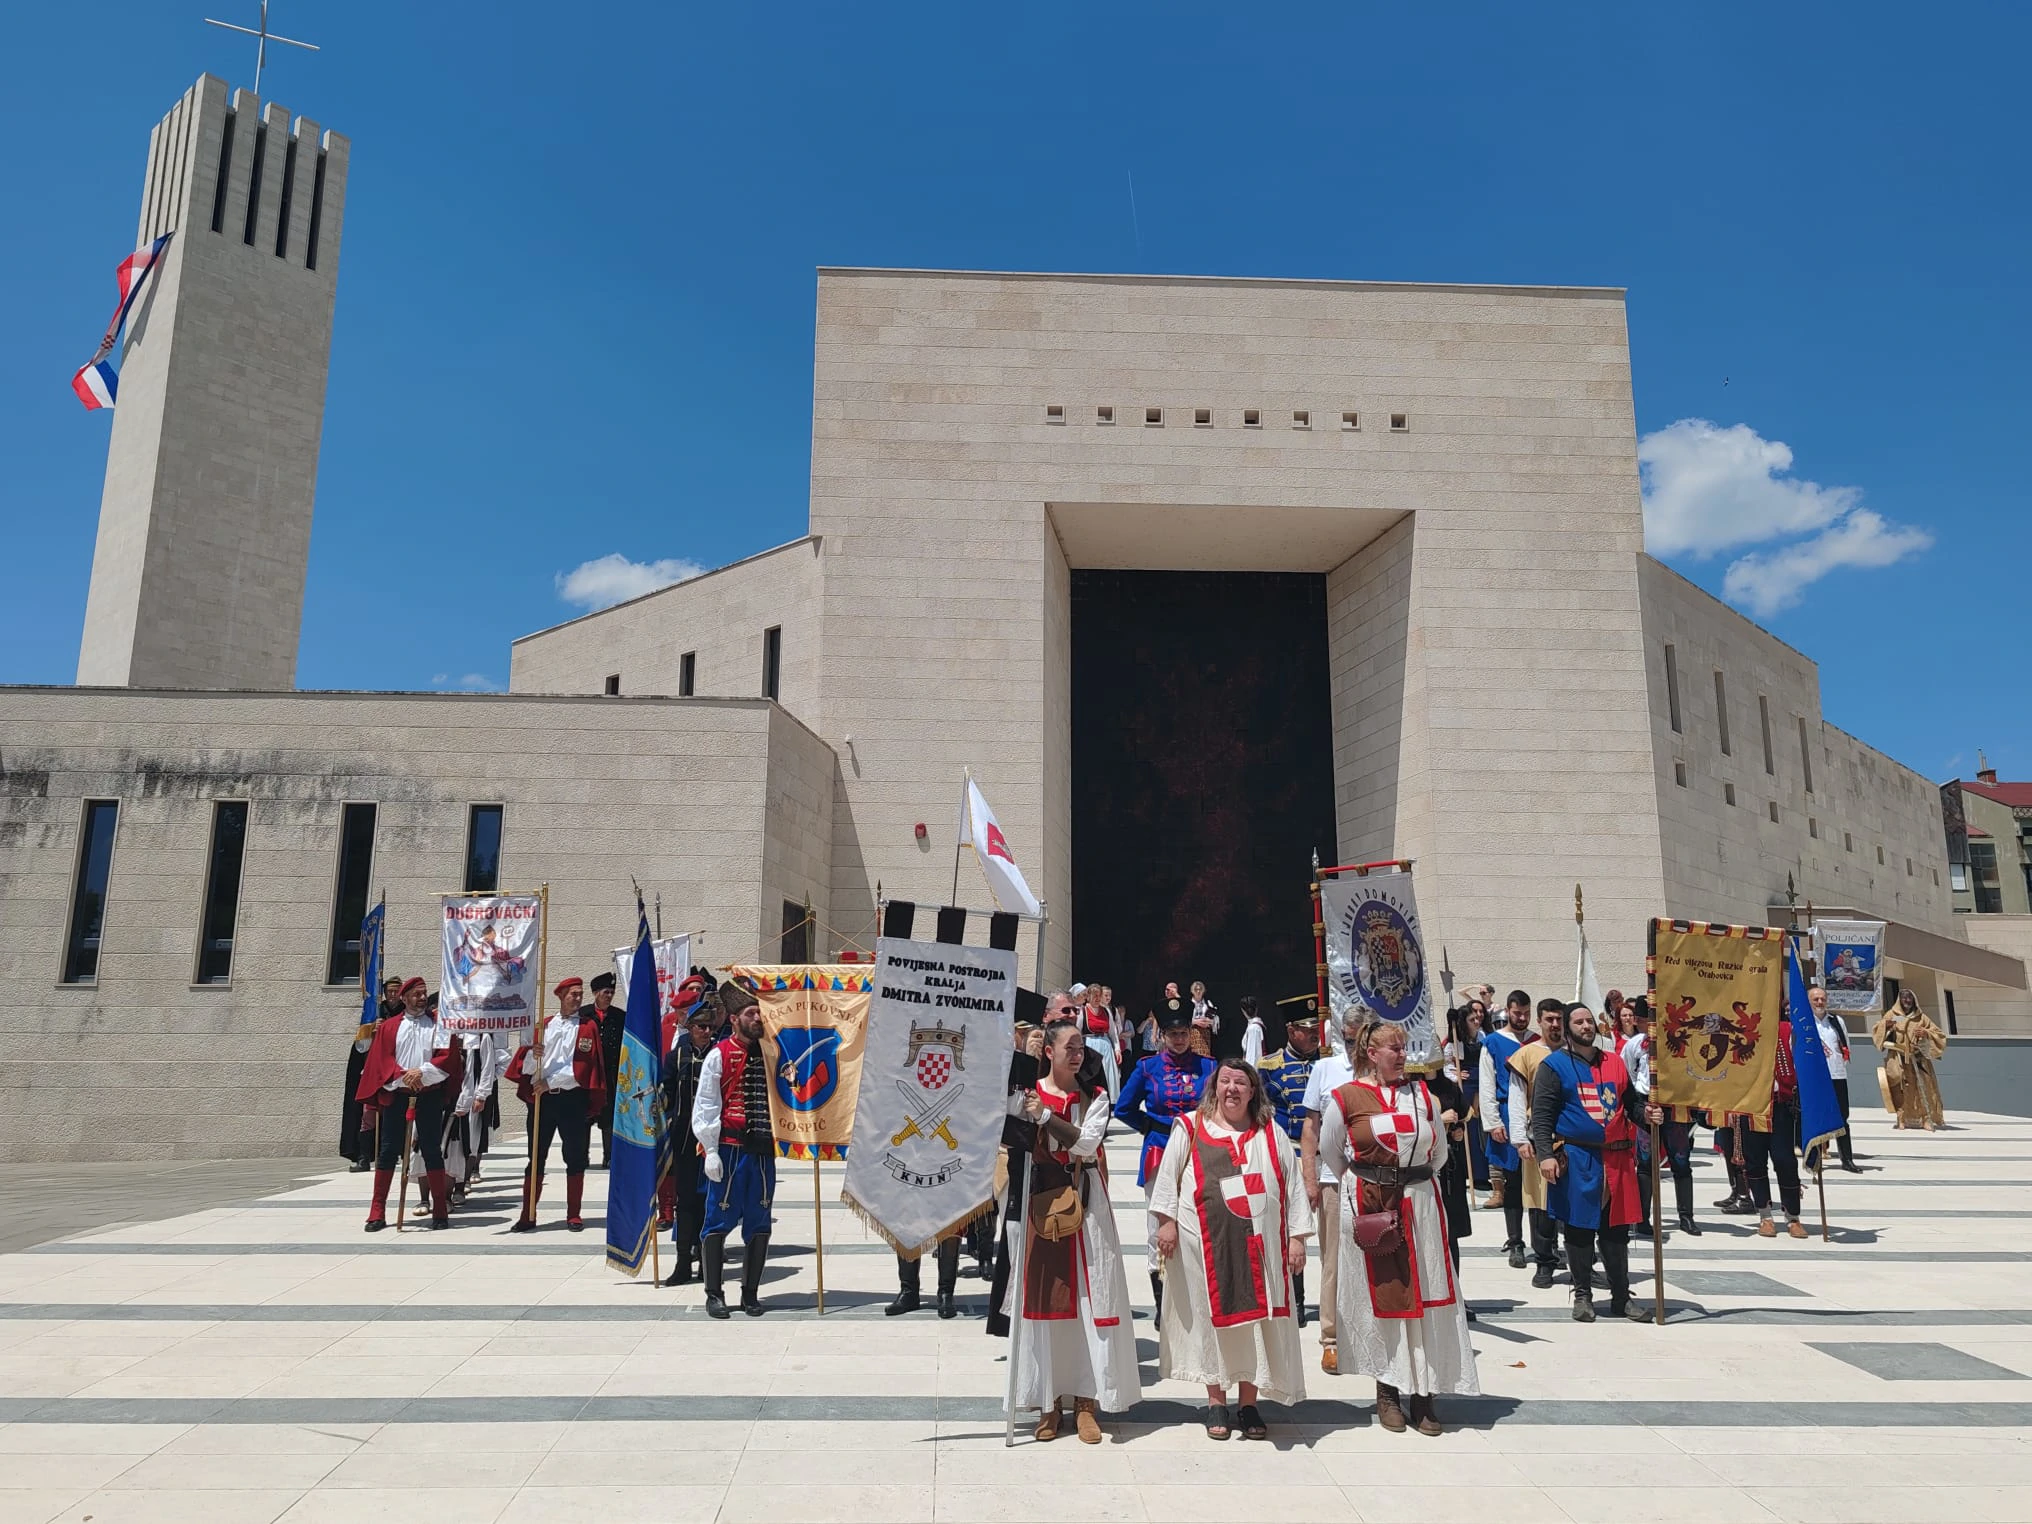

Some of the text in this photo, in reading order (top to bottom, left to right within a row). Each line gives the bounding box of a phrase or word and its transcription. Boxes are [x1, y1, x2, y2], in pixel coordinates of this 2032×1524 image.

[888, 956, 1006, 981] POVIJESNA POSTROJBA
[924, 976, 966, 992] KRALJA
[881, 987, 1005, 1012] DMITRA ZVONIMIRA
[441, 1015, 531, 1030] TROMBUNJERI
[900, 1171, 946, 1185] KNIN
